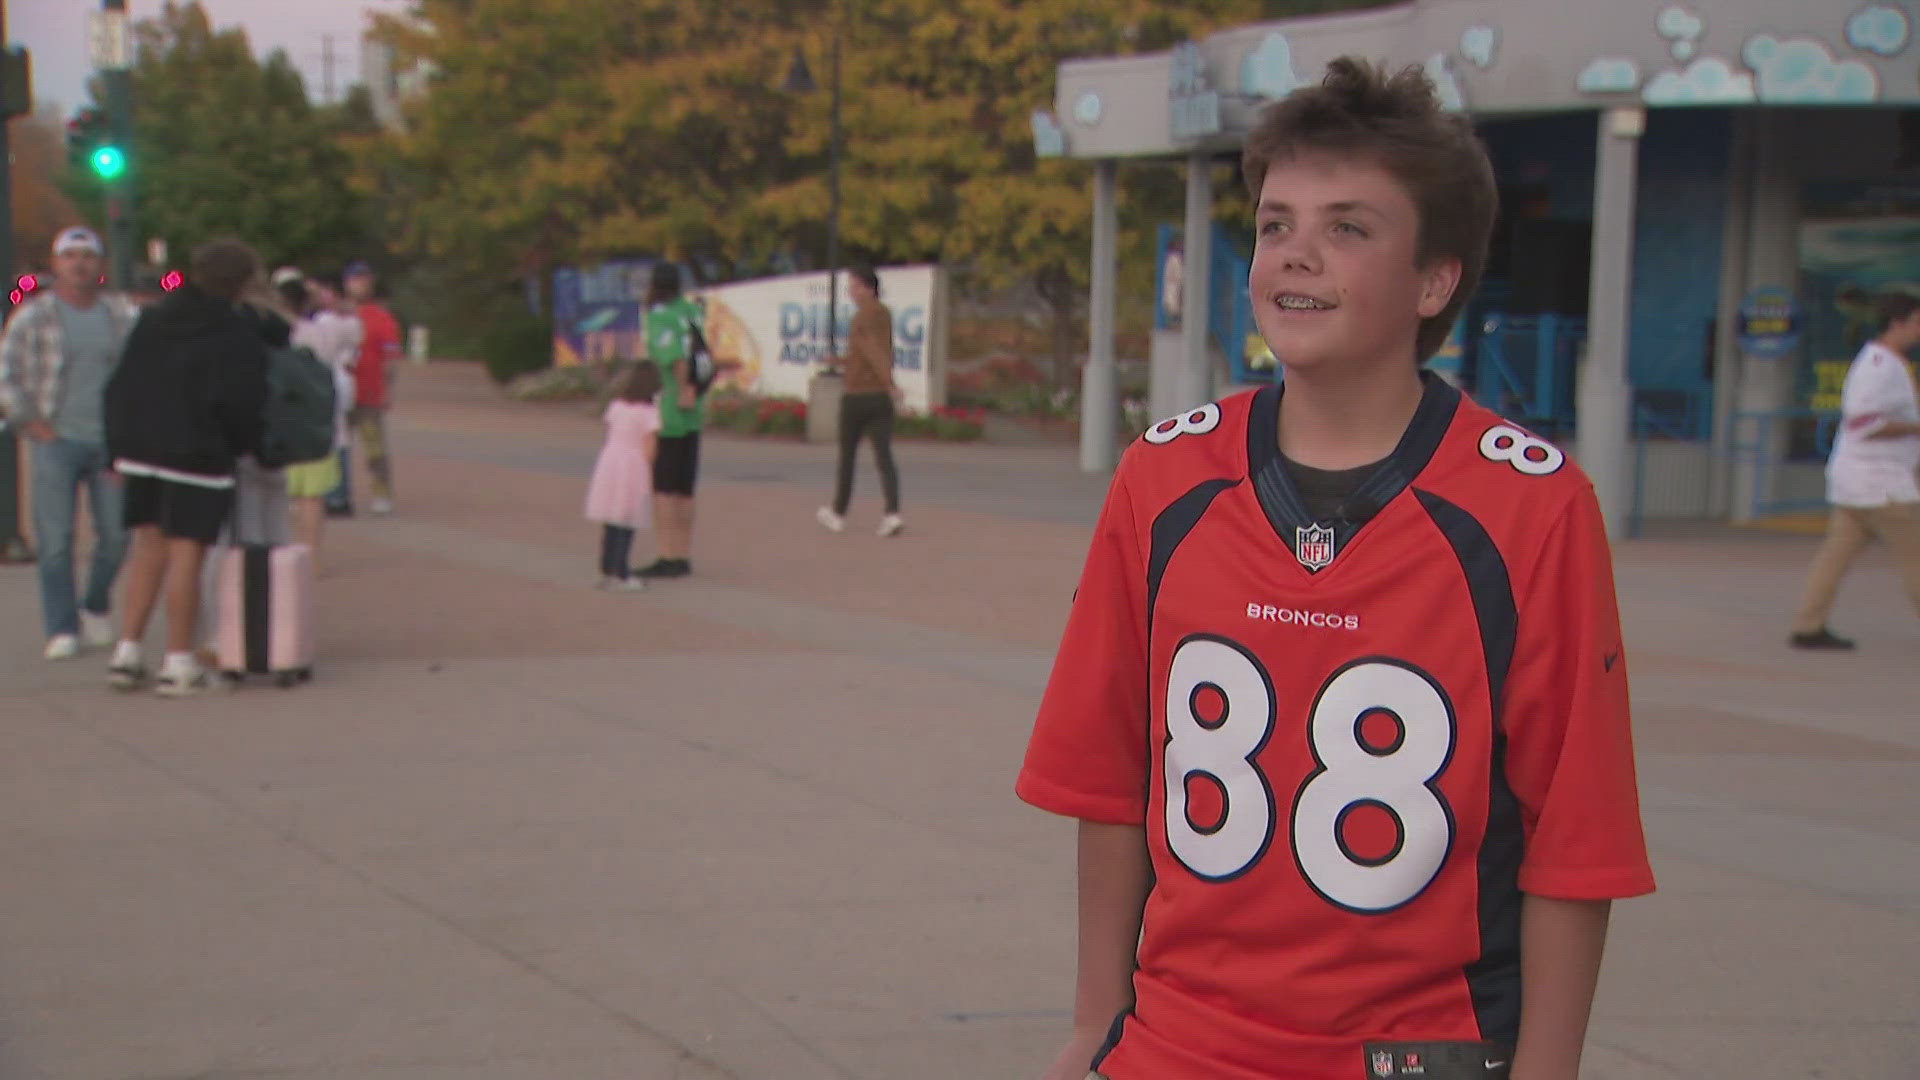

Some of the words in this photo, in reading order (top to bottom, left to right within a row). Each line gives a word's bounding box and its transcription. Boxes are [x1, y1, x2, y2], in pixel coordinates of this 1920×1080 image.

[1302, 544, 1329, 561] NFL
[1246, 602, 1359, 630] BRONCOS
[1164, 632, 1458, 915] 88
